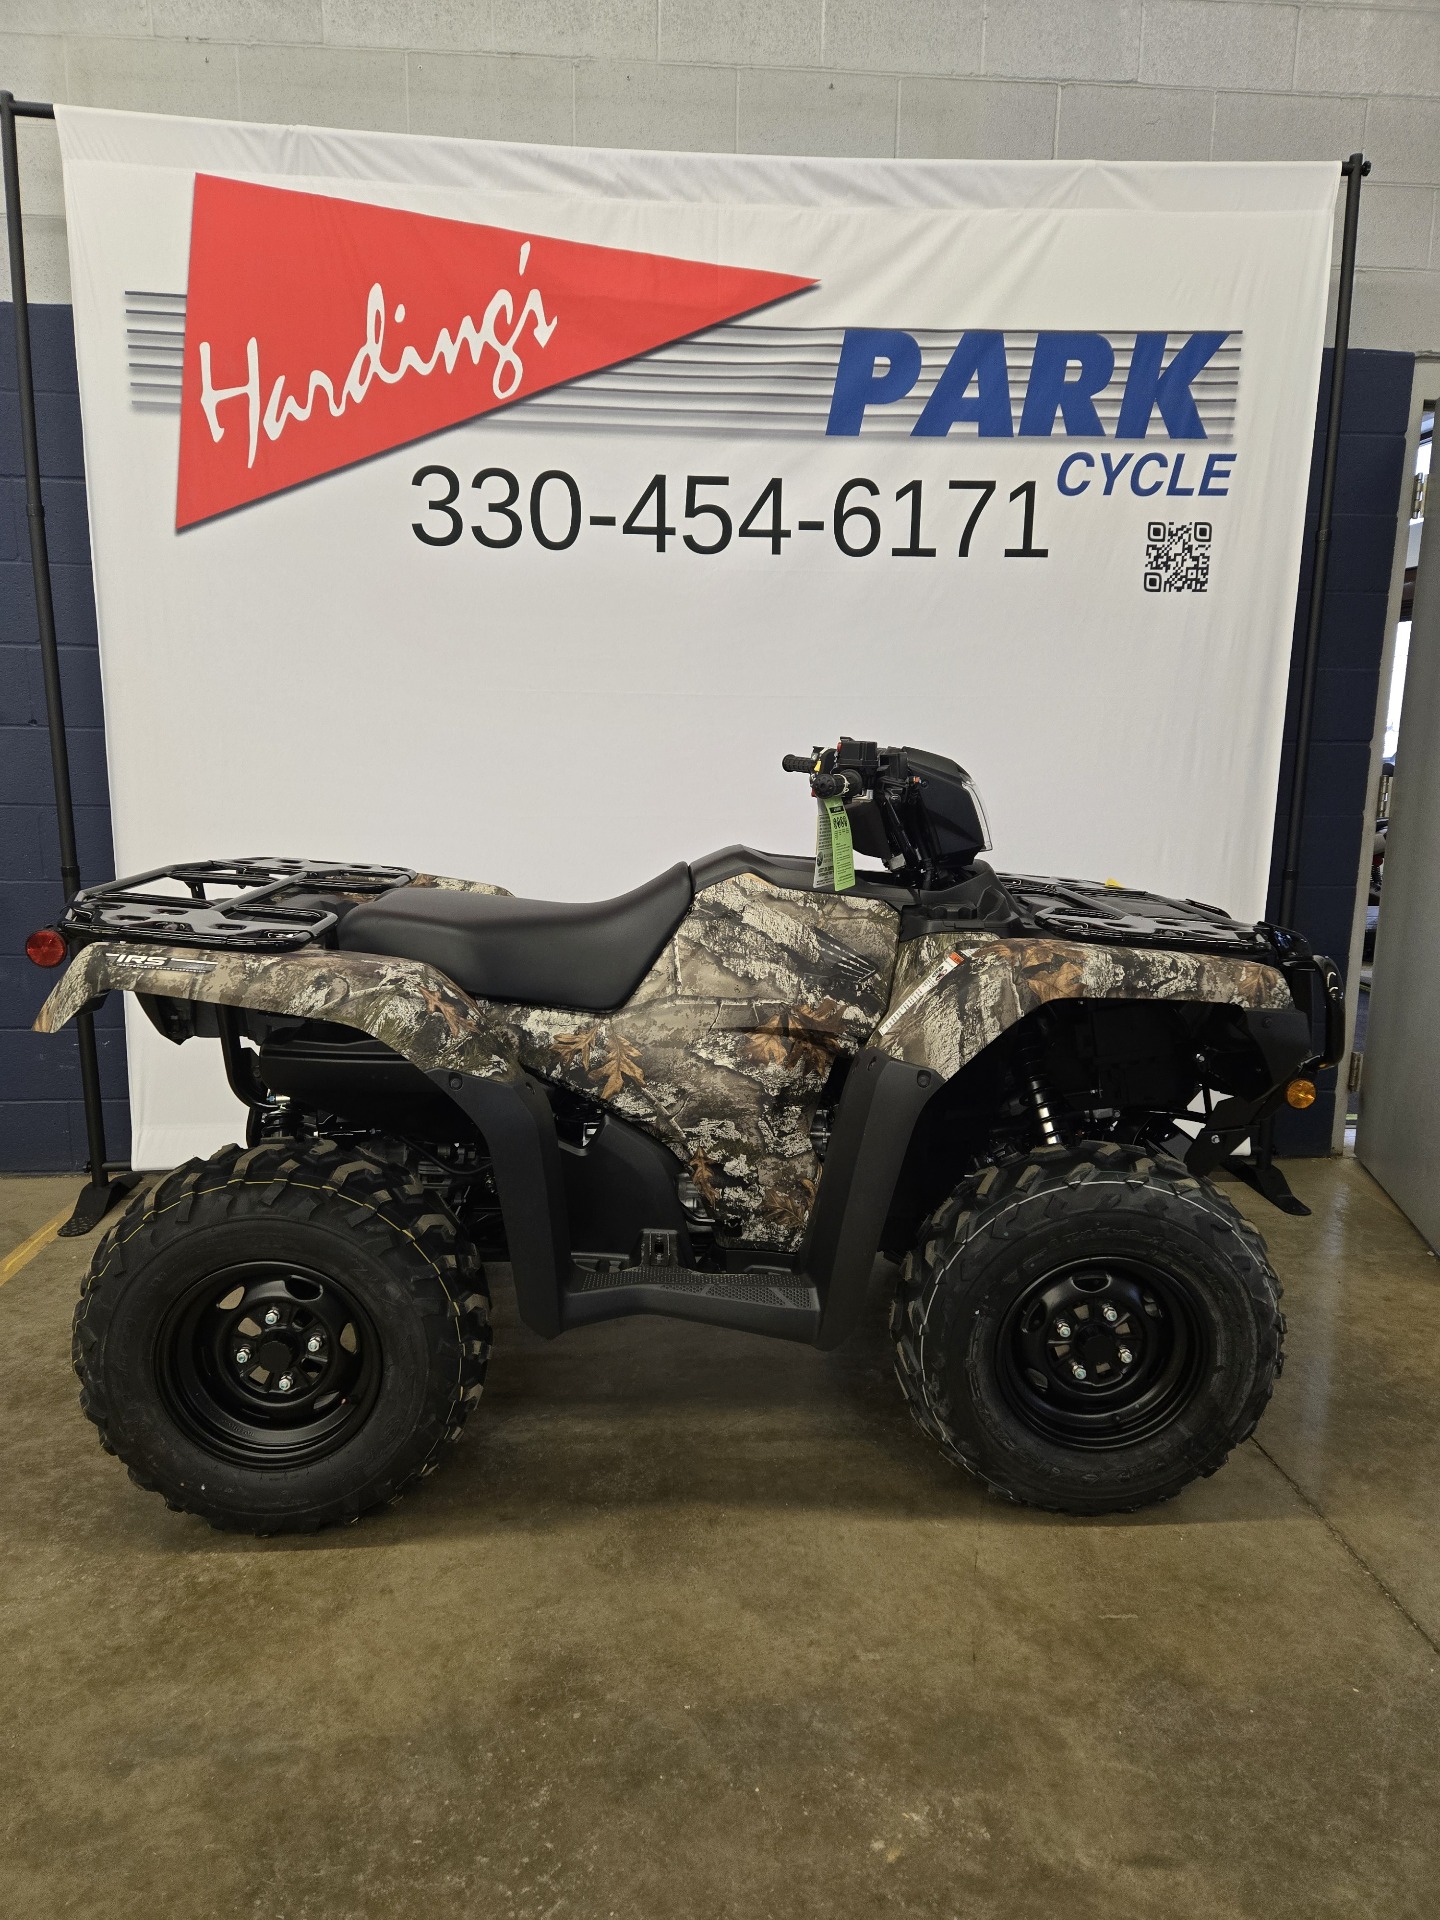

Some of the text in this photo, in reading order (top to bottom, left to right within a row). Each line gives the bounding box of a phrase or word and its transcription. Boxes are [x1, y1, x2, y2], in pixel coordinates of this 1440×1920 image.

[199, 241, 558, 468] Harding's
[825, 329, 1231, 439] PARK
[410, 464, 1050, 558] 330-454-6171
[1056, 451, 1237, 497] CYCLE
[116, 953, 168, 966] IRS
